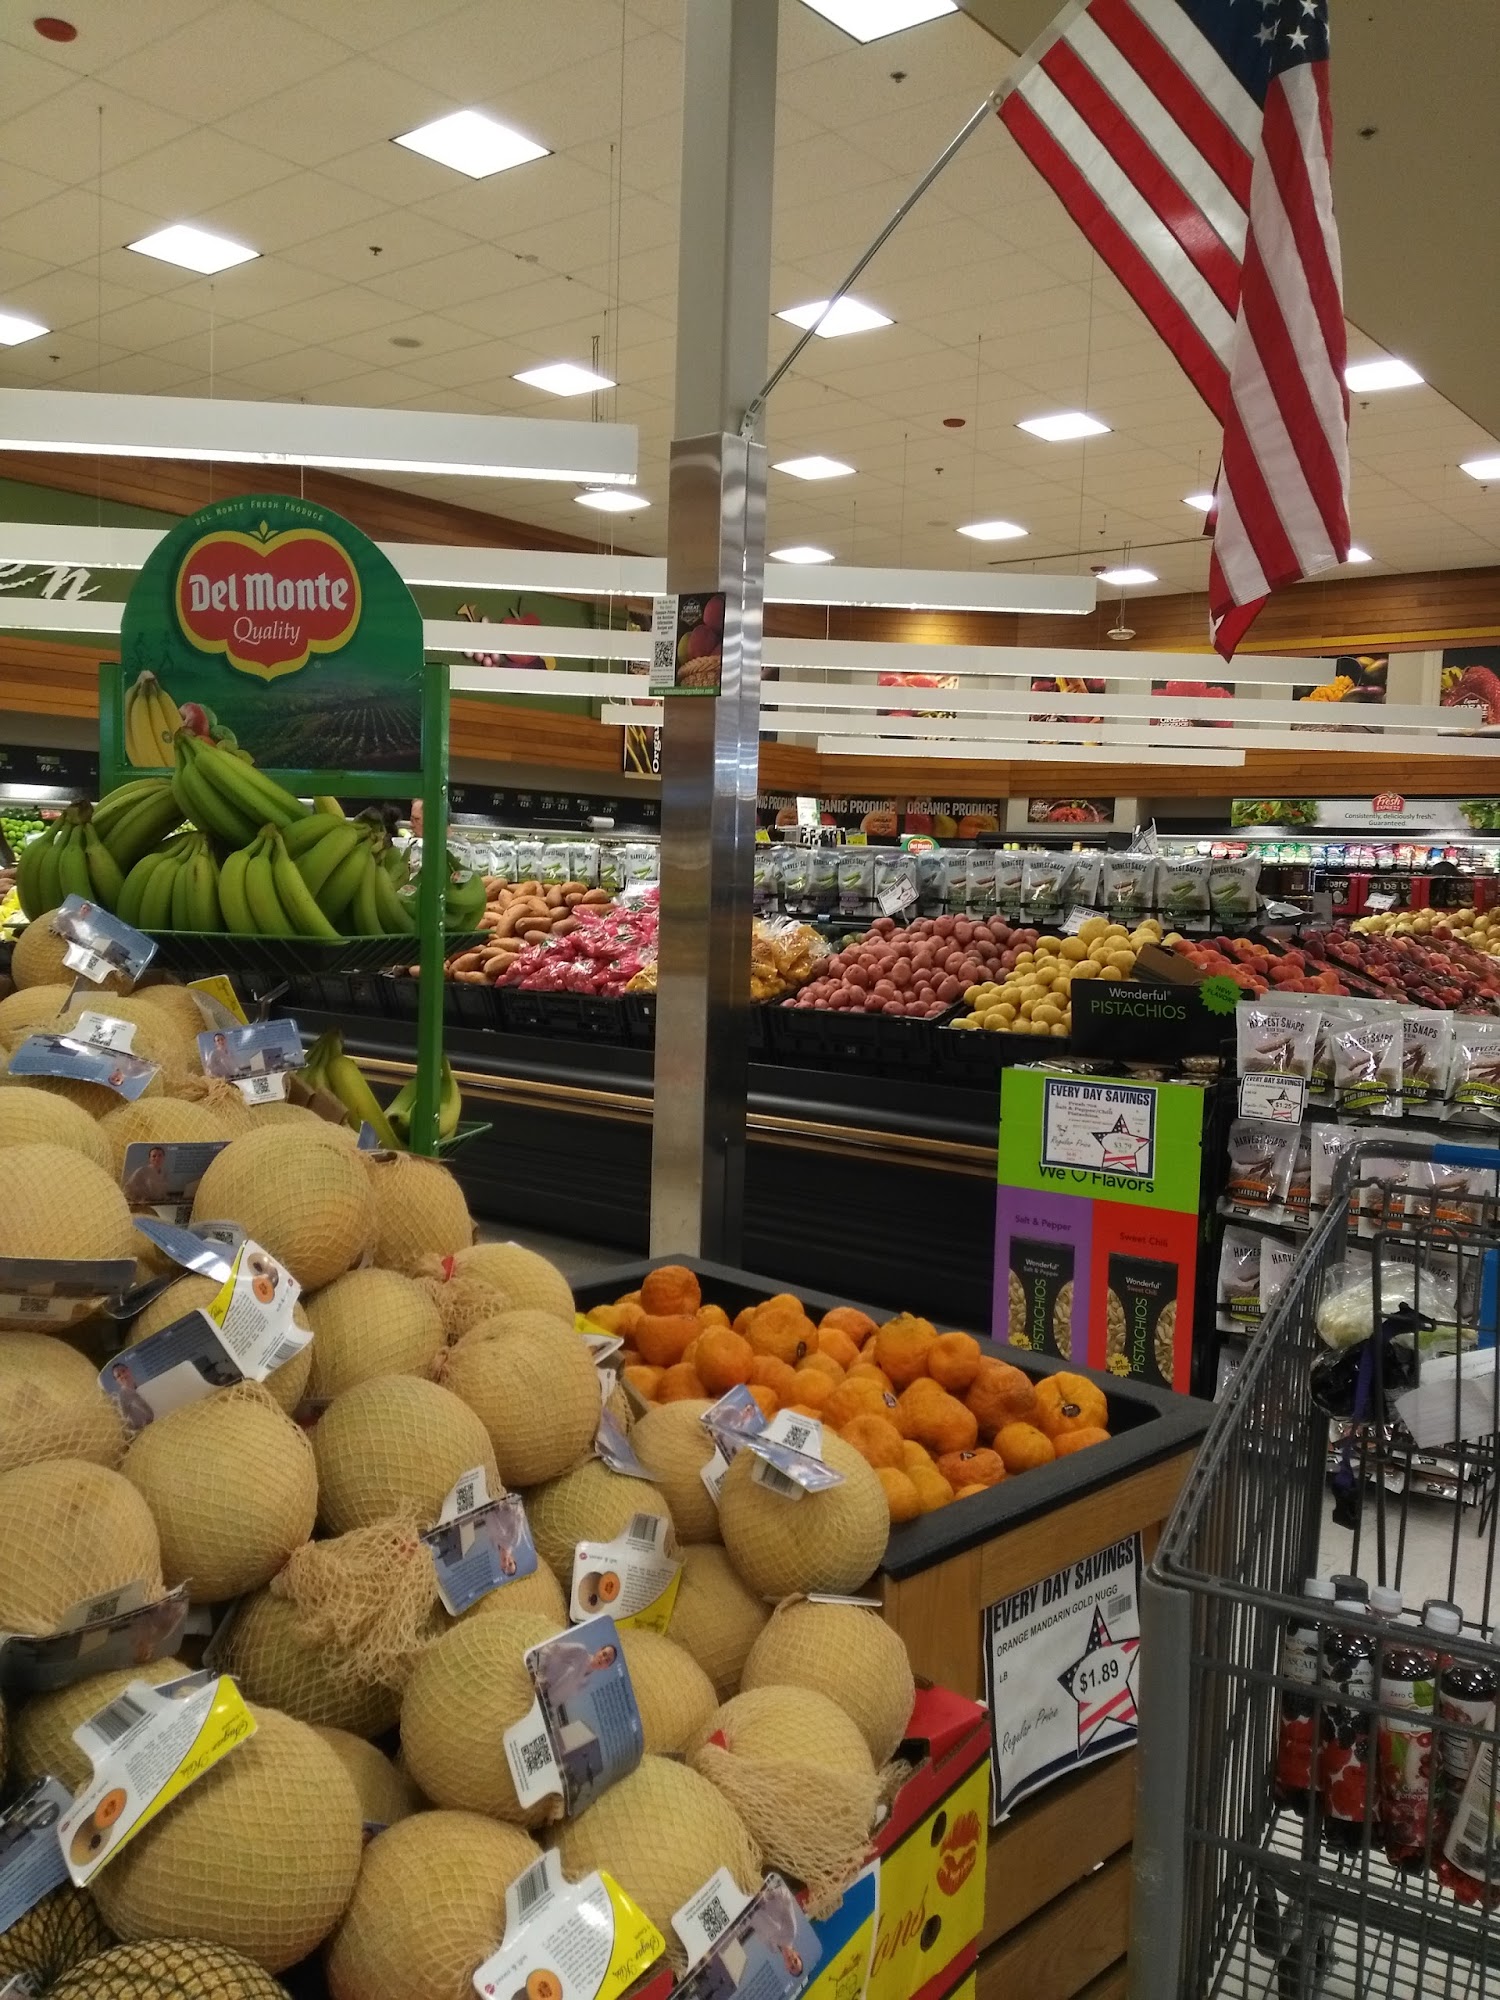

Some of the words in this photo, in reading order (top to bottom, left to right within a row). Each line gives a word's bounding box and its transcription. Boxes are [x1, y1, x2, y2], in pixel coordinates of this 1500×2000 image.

[194, 514, 212, 526] DEL
[216, 503, 244, 515] MONTE
[250, 500, 279, 509] FRESH
[285, 502, 324, 522] PRODUCE
[189, 573, 240, 612] Del
[242, 572, 349, 612] Monte
[233, 616, 301, 646] Quality
[849, 800, 896, 814] PRODUCE
[1377, 796, 1401, 806] Fresh
[906, 802, 951, 816] ORGANIC
[952, 803, 999, 817] PRODUCE
[1111, 862, 1131, 871] HARVEST
[1131, 862, 1147, 872] SNAPS
[1109, 987, 1167, 1001] Wonderful
[1207, 988, 1236, 1005] FLAVORS
[1215, 984, 1232, 996] NEW
[1091, 1000, 1186, 1020] PISTACHIOS
[1281, 1018, 1305, 1032] SNAPS
[1412, 1023, 1438, 1039] SNAPS
[1276, 1078, 1301, 1087] SAVINGS
[1050, 1085, 1080, 1098] EVERY
[1083, 1088, 1103, 1101] DAY
[1105, 1090, 1150, 1106] SAVINGS
[1050, 1136, 1073, 1147] Regular
[1076, 1139, 1091, 1148] Price
[1233, 1136, 1263, 1148] HARVEST
[1039, 1161, 1066, 1180] We
[1015, 1215, 1030, 1225] Salt
[1032, 1218, 1040, 1226] &
[1041, 1219, 1072, 1231] Pepper
[1120, 1232, 1146, 1245] Sweet
[1149, 1236, 1168, 1248] Chili
[1025, 1258, 1058, 1270] Wonderful
[1039, 1268, 1059, 1277] Pepper
[1125, 1276, 1161, 1290] Wonderful
[1032, 1278, 1047, 1351] PISTACHIOS
[1133, 1297, 1148, 1373] PISTACHIOS
[993, 1585, 1039, 1634] EVERY
[1042, 1568, 1071, 1607] DAY
[1075, 1537, 1134, 1590] SAVINGS
[997, 1630, 1029, 1657] ORANGE
[1030, 1608, 1071, 1638] MANDARIN
[1072, 1596, 1093, 1614] GOLD
[1095, 1584, 1118, 1602] NUGG
[999, 1671, 1008, 1683] LB
[1079, 1659, 1119, 1694] $1.89
[1390, 1690, 1405, 1699] Zero
[1002, 1719, 1032, 1756] Regular
[1035, 1707, 1059, 1730] Price
[635, 1935, 660, 1961] Sugar
